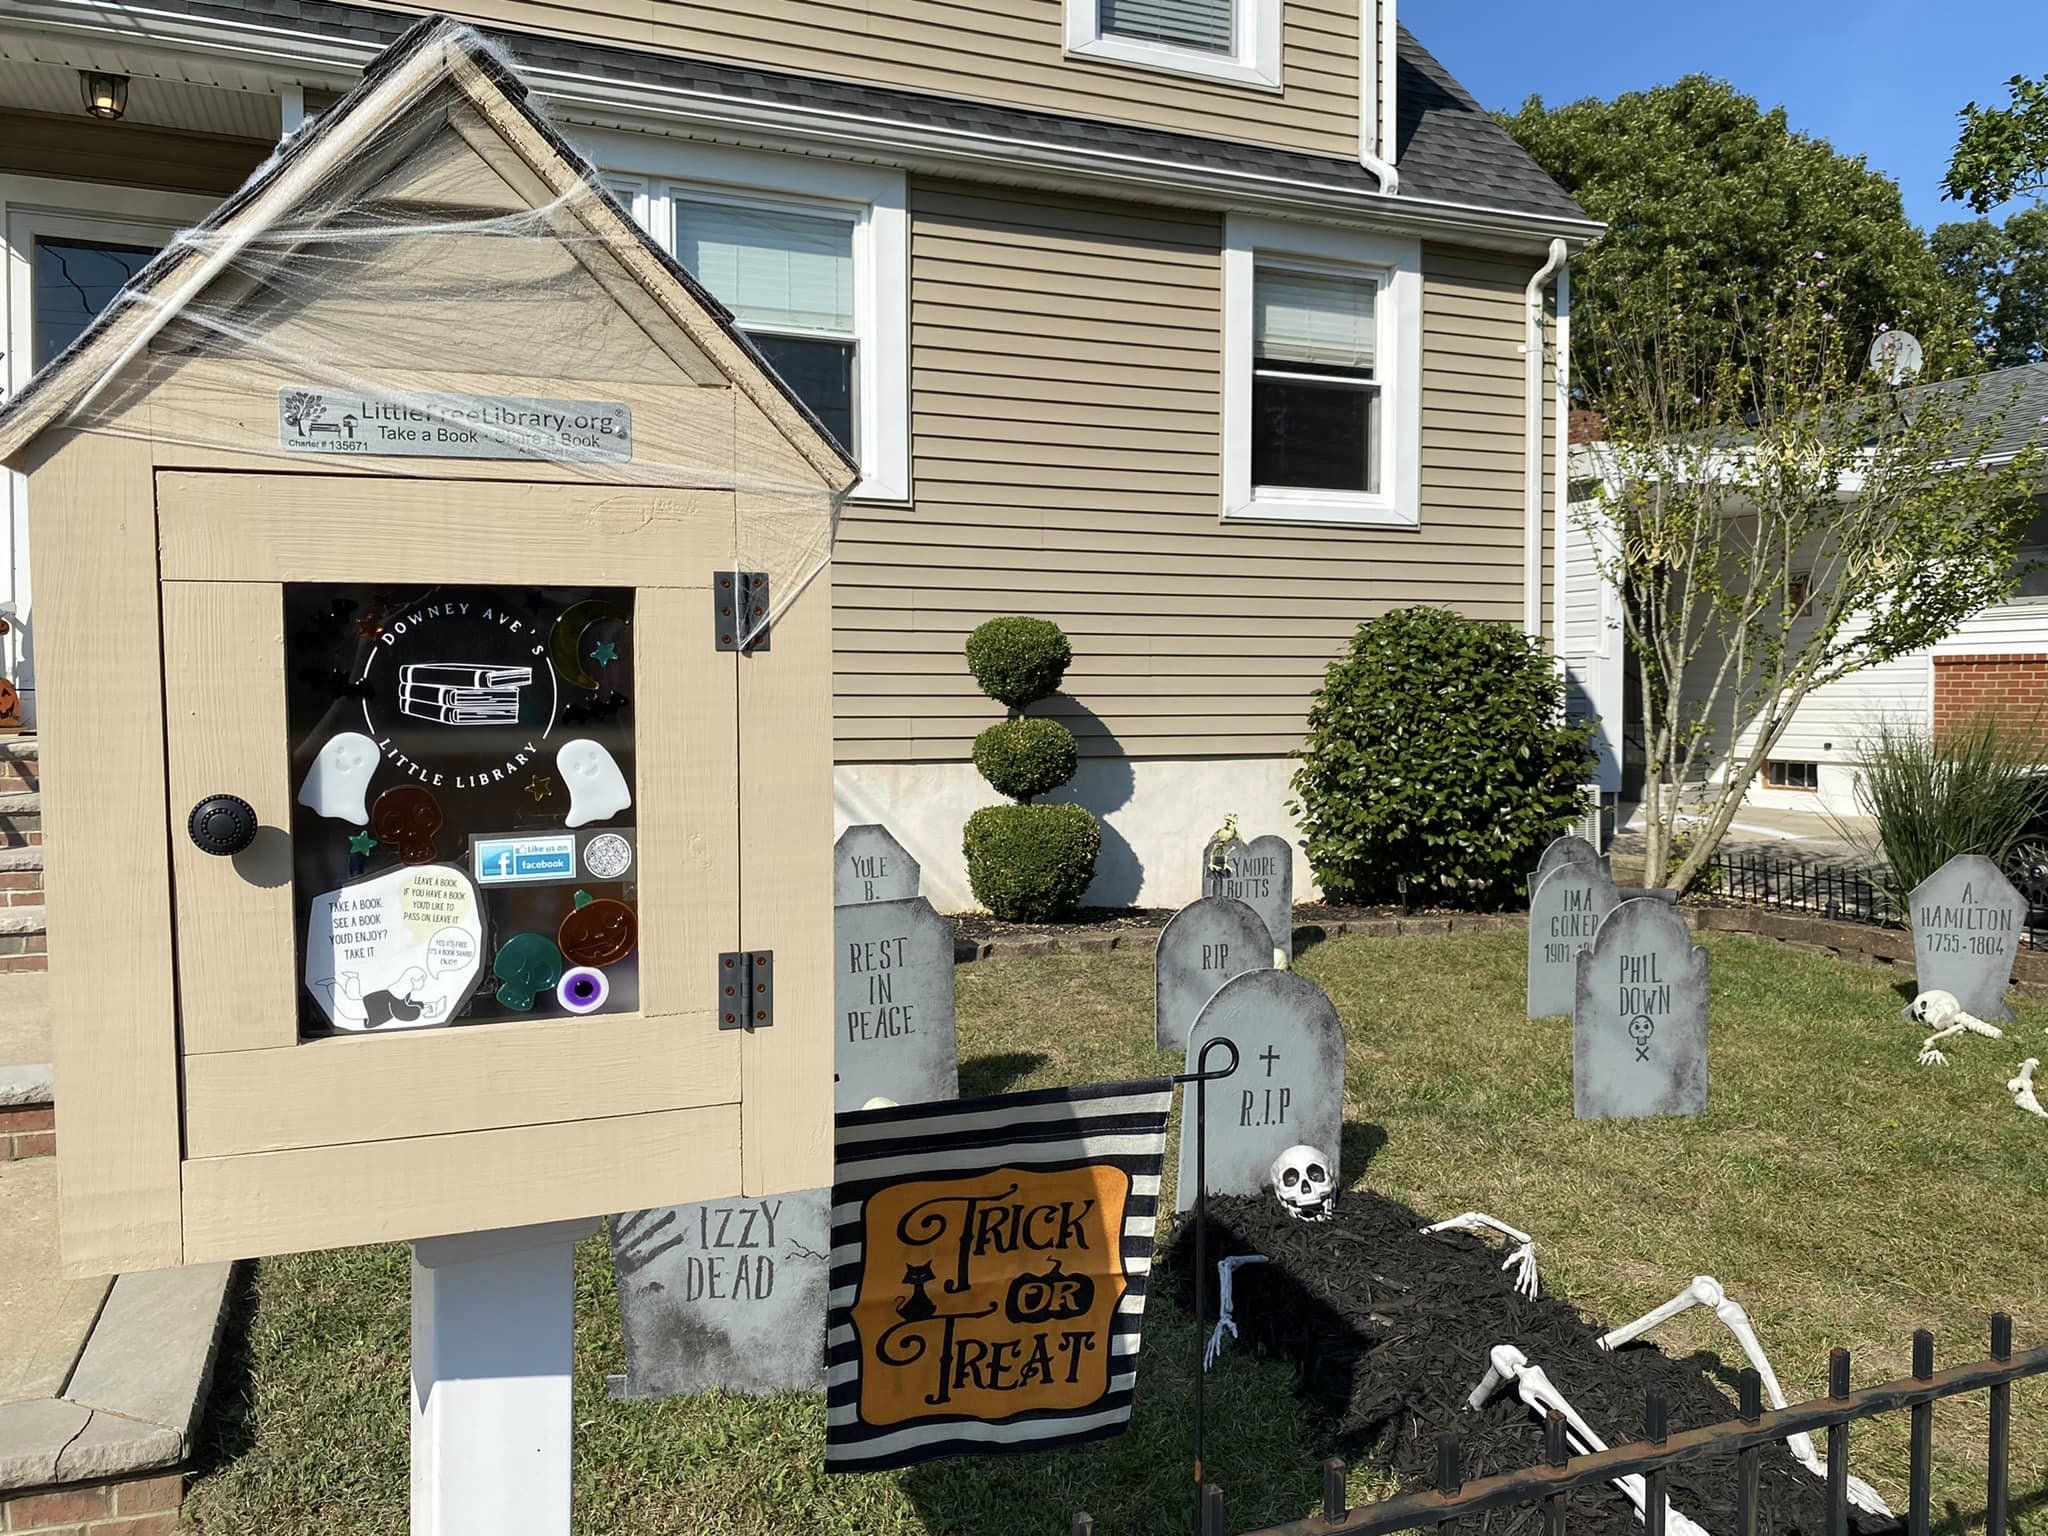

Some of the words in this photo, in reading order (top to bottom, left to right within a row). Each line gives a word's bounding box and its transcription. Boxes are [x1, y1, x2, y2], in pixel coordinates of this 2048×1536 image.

[288, 440, 319, 449] Charter
[329, 441, 368, 451] 135671
[378, 425, 416, 441] Take
[422, 430, 431, 441] a
[437, 428, 479, 443] Book
[560, 432, 600, 448] Book
[381, 602, 470, 646] DOWNEY
[483, 607, 544, 656] AVE'S
[378, 737, 444, 786] LITTLE
[456, 740, 538, 789] LIBRARY
[528, 844, 543, 853] Like
[557, 844, 568, 852] on
[522, 858, 564, 870] facebook
[851, 856, 888, 878] YULE
[1220, 857, 1277, 878] YMORE
[414, 876, 433, 886] LEAVE
[1961, 881, 1980, 904] A.
[411, 888, 425, 897] YOU
[426, 889, 442, 899] HAVE
[1563, 887, 1592, 912] IMA
[328, 900, 350, 913] TAKE
[352, 899, 358, 911] A
[403, 911, 421, 921] PASS
[432, 914, 451, 924] LEAVE
[431, 902, 444, 911] LIKE
[446, 902, 455, 911] TO
[1921, 905, 2012, 931] HAMILTON
[333, 916, 349, 929] SEE
[351, 915, 357, 927] A
[359, 913, 382, 927] BOOK
[355, 928, 388, 943] ENJOY?
[344, 947, 366, 960] TAKE
[850, 937, 908, 974] REST
[1202, 944, 1228, 970] RIP
[1619, 953, 1662, 984] PHIL
[869, 973, 892, 1005] IN
[1619, 985, 1670, 1016] DOWN
[848, 1005, 915, 1042] PEACE
[699, 1200, 783, 1251] IZZY
[897, 1184, 1094, 1293] TRICK
[686, 1254, 774, 1302] DEAD
[1017, 1281, 1080, 1315] OR
[875, 1301, 1096, 1405] TREAT
